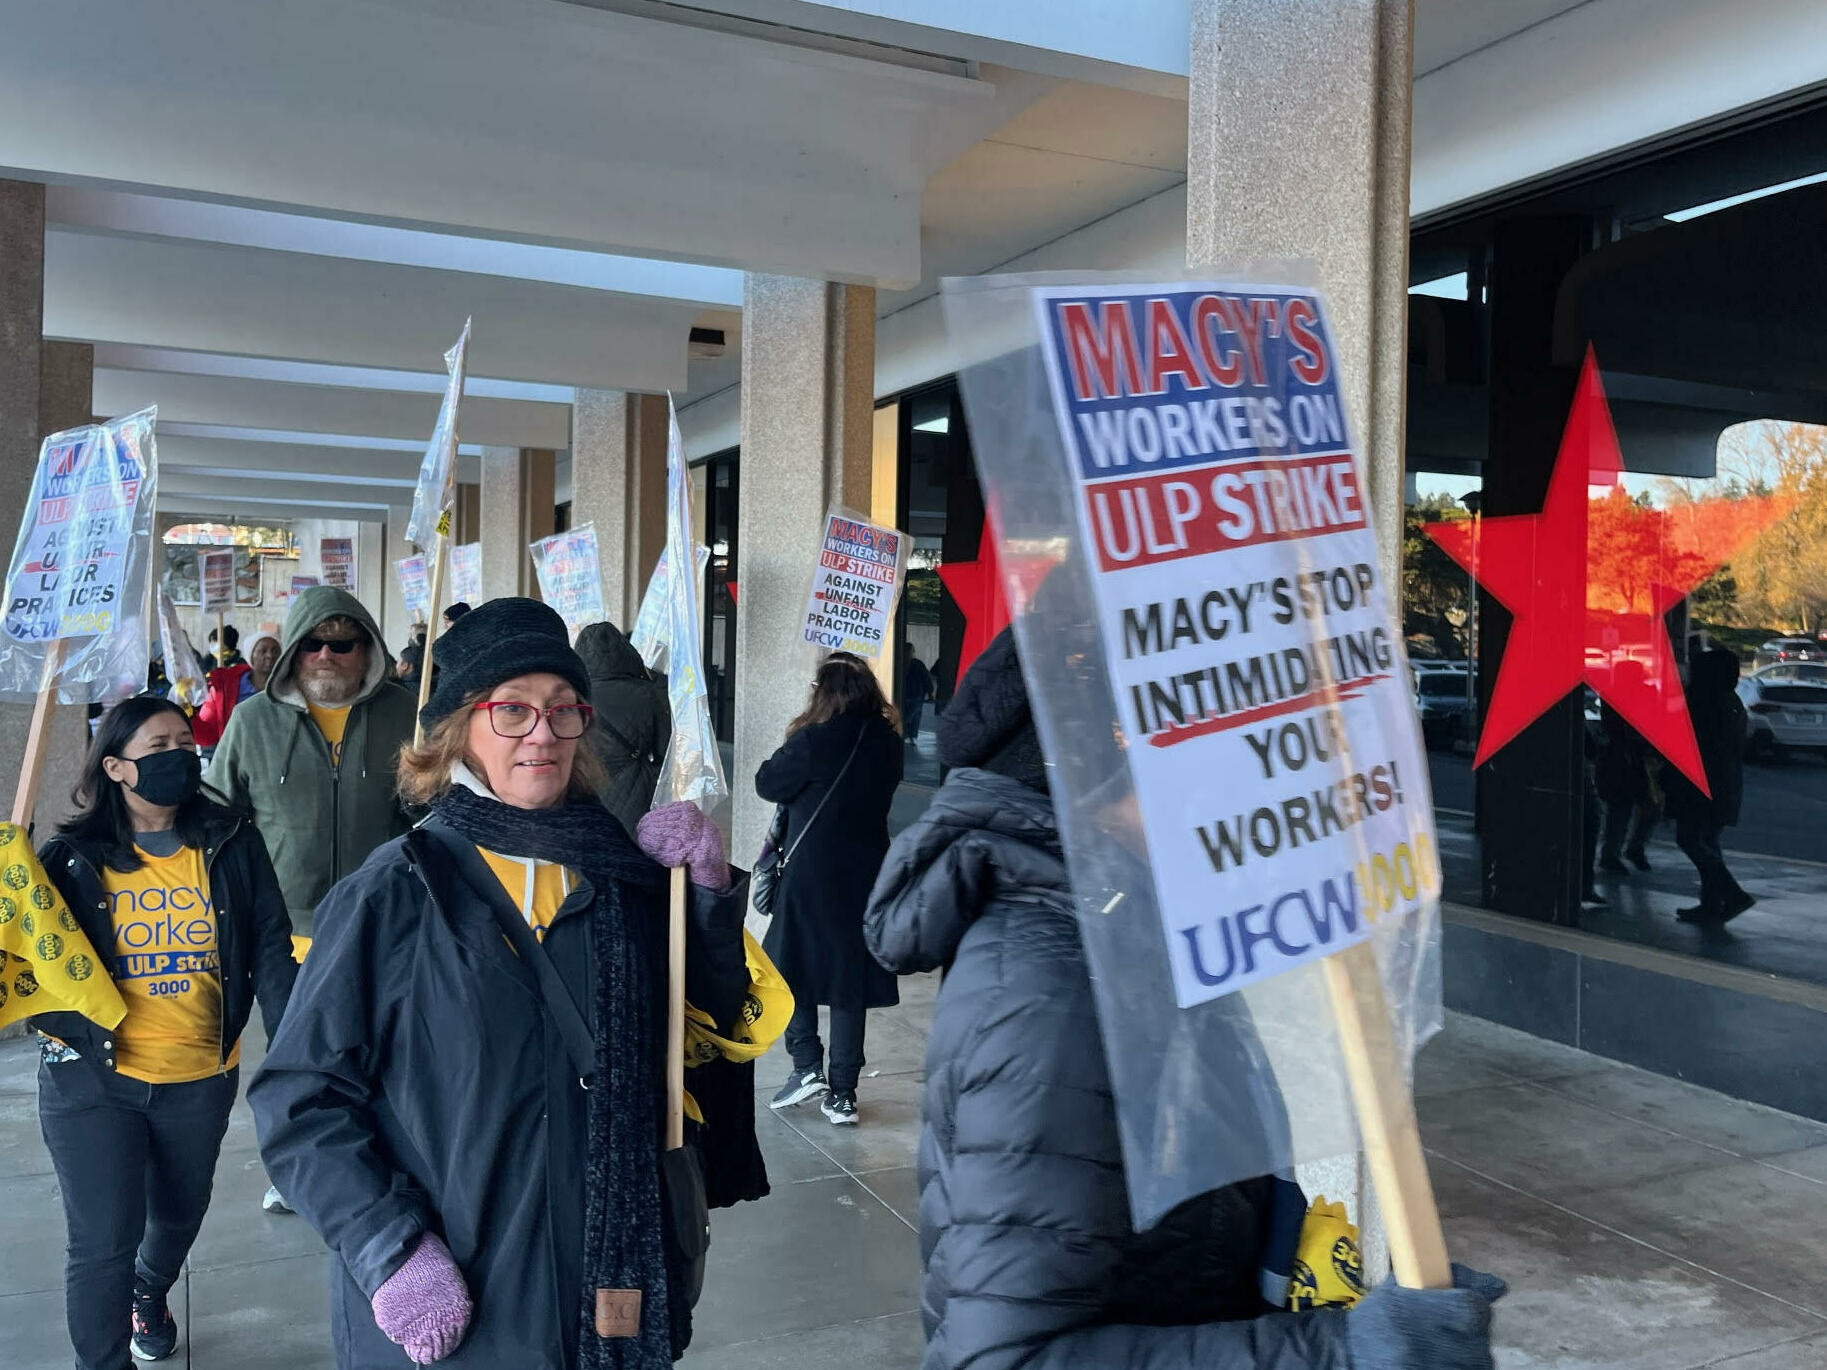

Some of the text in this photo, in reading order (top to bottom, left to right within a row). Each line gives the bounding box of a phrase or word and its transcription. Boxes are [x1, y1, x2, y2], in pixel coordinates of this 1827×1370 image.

[1057, 296, 1330, 402] MACY'S
[1077, 394, 1343, 468] WORKERS ON
[118, 462, 138, 481] ON
[1094, 462, 1363, 562] ULP STRIKE
[829, 518, 898, 553] MACY'S
[827, 538, 895, 566] WORKERS ON
[40, 563, 99, 592] LOR
[821, 552, 894, 583] ULP STRIKE
[824, 573, 883, 597] AGAINST
[825, 588, 876, 610] UNFAIR
[9, 584, 115, 616] PRAICES
[823, 602, 870, 624] LABOR
[1120, 563, 1374, 660] MACY'S STOP
[807, 613, 882, 641] PRACTICES
[1197, 760, 1404, 873] WORKERS!
[127, 954, 170, 976] ULP
[148, 979, 190, 996] 3000
